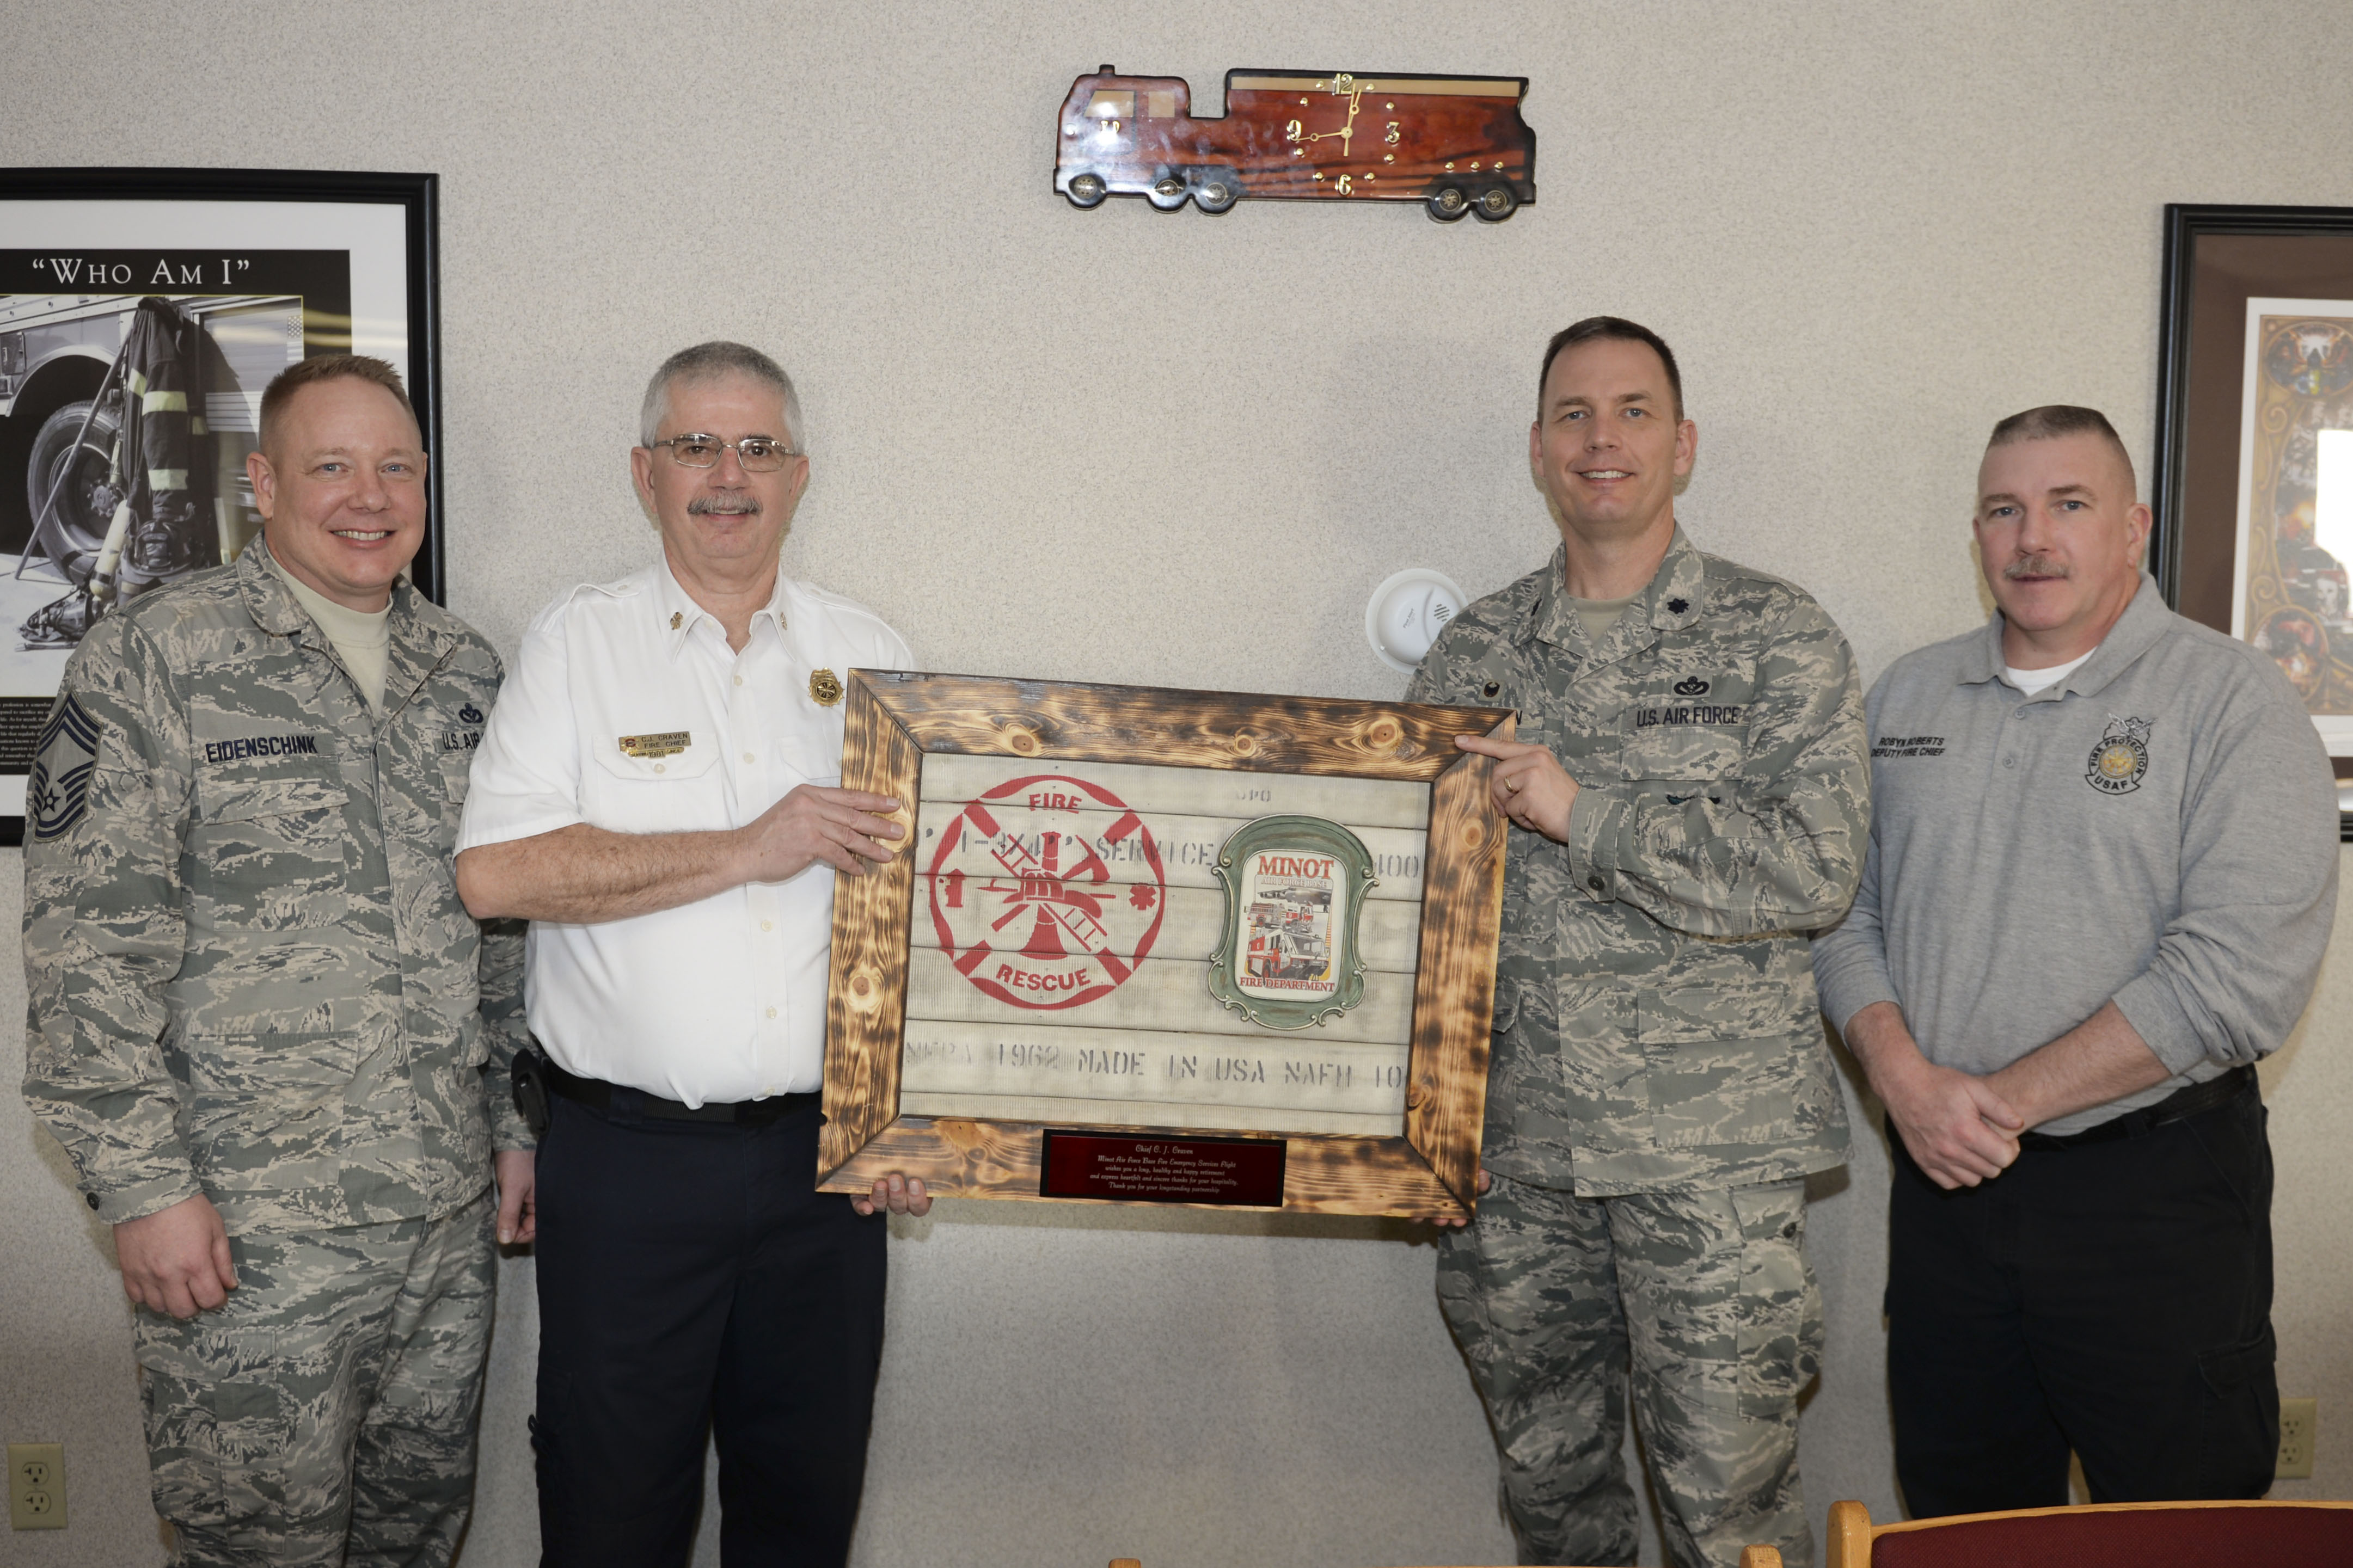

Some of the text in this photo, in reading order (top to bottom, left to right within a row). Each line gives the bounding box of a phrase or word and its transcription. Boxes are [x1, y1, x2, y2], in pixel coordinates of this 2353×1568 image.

[1333, 73, 1353, 95] 12
[1288, 119, 1302, 141] 9
[1387, 121, 1400, 143] 3
[1338, 174, 1352, 195] 6
[1637, 706, 1739, 727] U.S. AIR FORCE
[205, 736, 318, 763] EIDENSCHINK
[442, 731, 480, 750] U.S. AIR
[1906, 736, 1945, 746] ROBERTS
[1871, 747, 1945, 758] DEPUTY FIRE CHIEF
[2105, 739, 2146, 775] PROTECTION
[2094, 776, 2128, 790] USAF
[1028, 792, 1082, 814] FIRE
[1095, 837, 1214, 866] SERVICE
[1257, 855, 1334, 880] MINOT
[1261, 877, 1327, 888] AIR FORCE BASE
[996, 963, 1091, 992] RESCUE
[1240, 977, 1335, 993] FIRE DEPARTMENT
[1079, 1049, 1145, 1075] MADE
[1169, 1055, 1197, 1078] IN
[1215, 1057, 1264, 1083] USA
[1136, 1145, 1152, 1153] Chief
[1172, 1146, 1193, 1154] Craven
[1169, 1159, 1196, 1167] Emergency
[1159, 1184, 1191, 1193] longstanding
